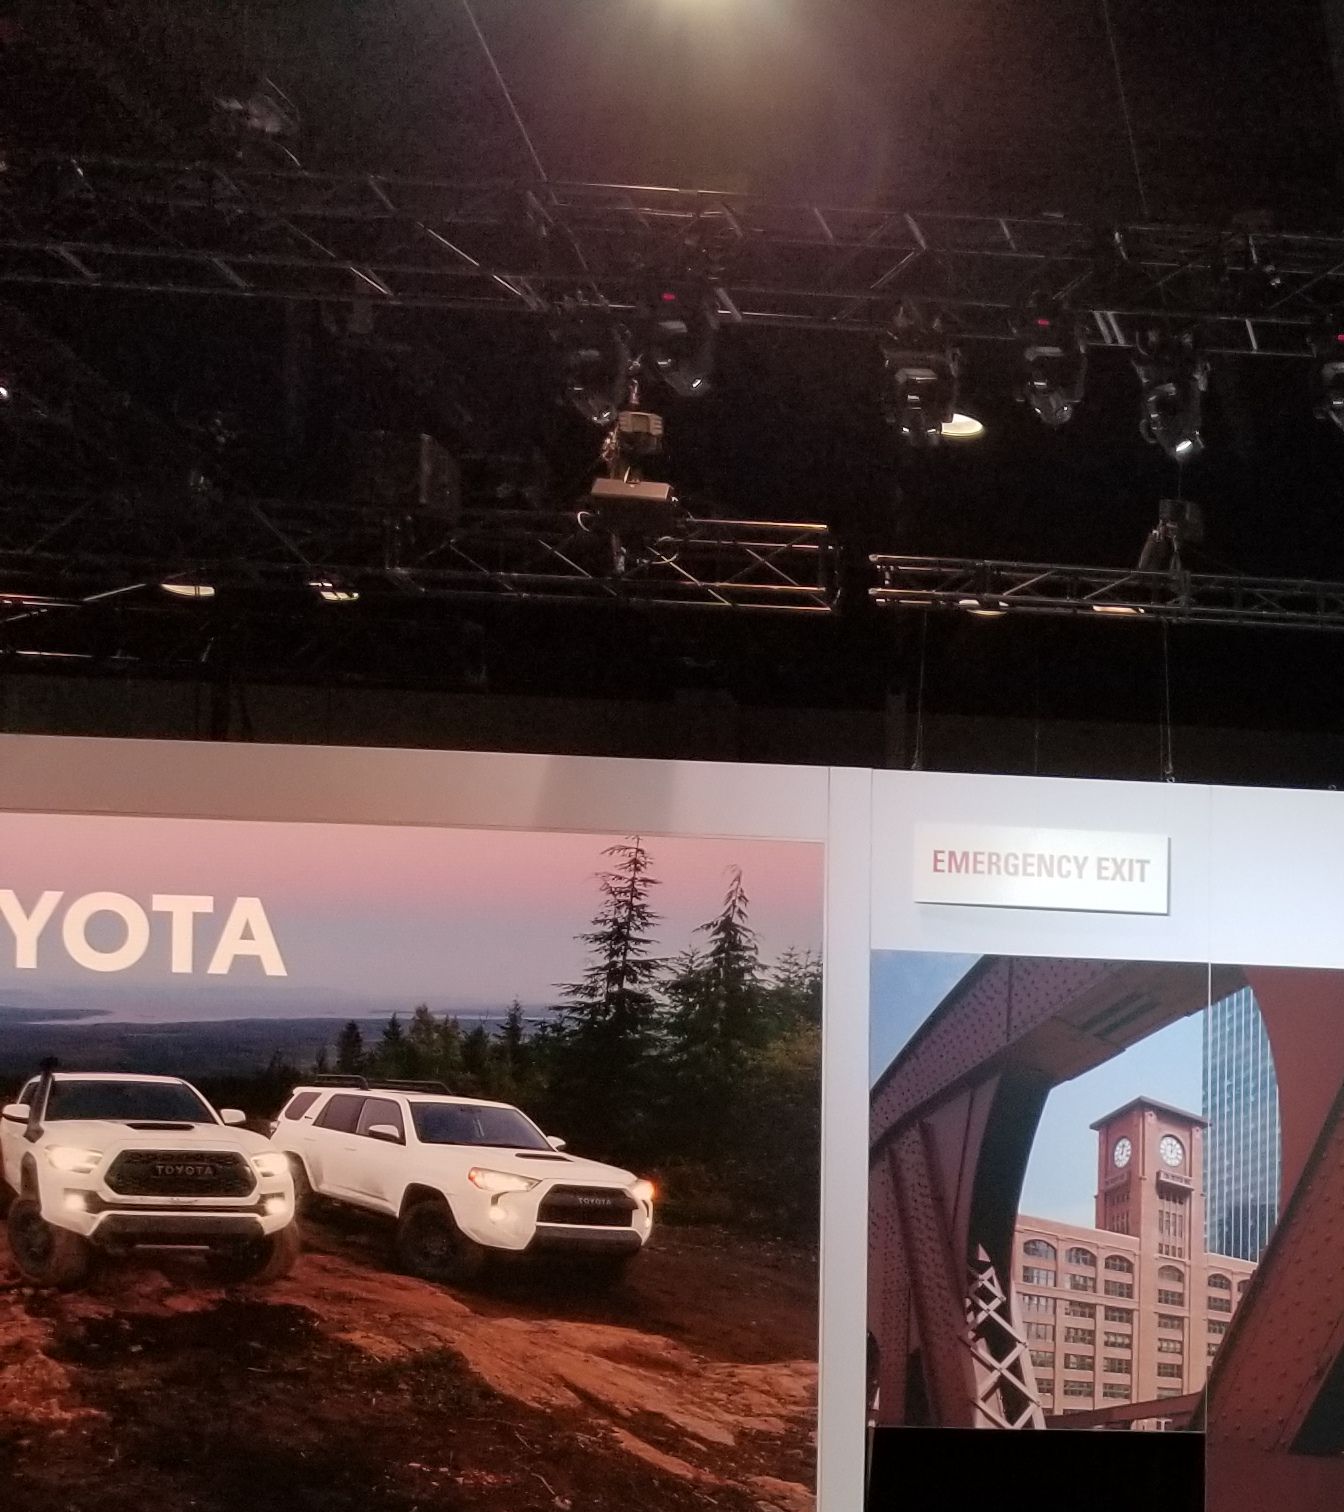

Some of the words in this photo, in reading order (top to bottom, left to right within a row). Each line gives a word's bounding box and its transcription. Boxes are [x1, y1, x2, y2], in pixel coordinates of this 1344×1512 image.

[931, 849, 1089, 880] EMERGENCY
[1096, 856, 1151, 883] EXIT
[0, 888, 289, 977] YOTA
[156, 1164, 214, 1176] TOYOTA
